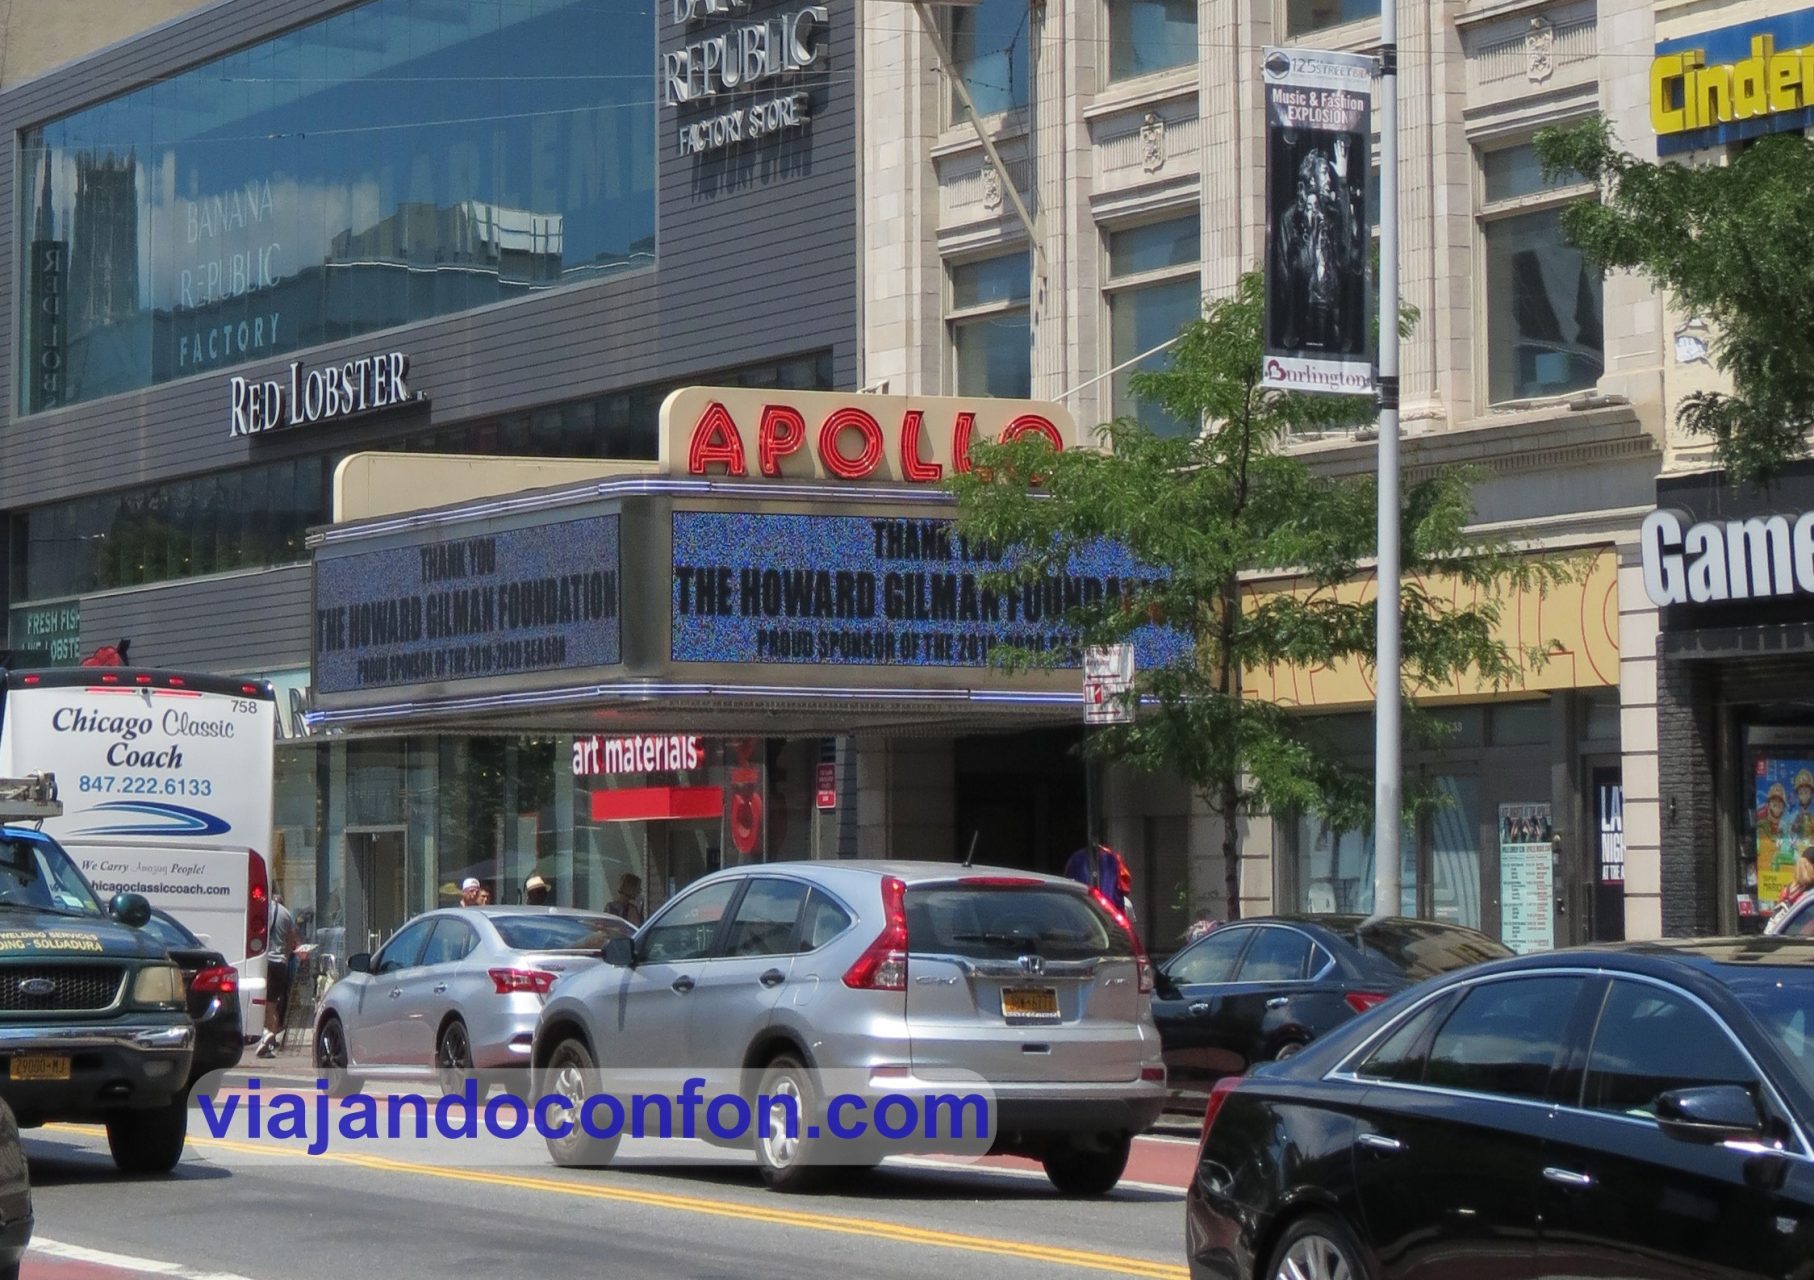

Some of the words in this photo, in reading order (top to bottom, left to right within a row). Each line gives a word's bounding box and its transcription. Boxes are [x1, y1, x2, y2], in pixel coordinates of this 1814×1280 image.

[663, 6, 828, 107] REPUBLIC
[1272, 88, 1306, 106] Music
[1309, 92, 1319, 107] &
[1321, 91, 1364, 112] Fashion
[1288, 105, 1349, 124] EXPLOSION
[679, 109, 744, 157] FACTORY
[749, 93, 809, 137] STORE
[187, 178, 273, 244] BANANA
[181, 242, 281, 311] REPUBLIC
[180, 313, 280, 367] FACTORY
[1266, 359, 1371, 390] Burlington
[229, 375, 281, 438] RED
[289, 352, 408, 425] LOBSTER
[420, 541, 467, 584] THANK
[468, 538, 496, 576] YOU
[318, 606, 345, 652] THE
[350, 596, 422, 647] HOWARD
[426, 586, 494, 638] GILMAN
[499, 570, 617, 631] FOUNDATION
[676, 568, 732, 616] THE
[740, 569, 875, 619] HOWARD
[884, 571, 999, 621] GILMAN
[27, 611, 58, 635] FRESH
[757, 629, 813, 658] PROUD
[819, 630, 895, 659] SPONSOR
[900, 631, 919, 660] OF
[923, 632, 952, 661] THE
[52, 707, 153, 740] Chicago
[162, 708, 235, 738] Classic
[231, 700, 258, 714] 758
[107, 742, 183, 769] Coach
[573, 736, 599, 775] art
[605, 735, 698, 773] materials
[79, 775, 212, 796] 847.222.6133
[1601, 785, 1623, 832] LA
[81, 860, 98, 870] We
[100, 861, 129, 873] Carry
[171, 862, 206, 875] People!
[91, 881, 230, 896] hicagoclassiccoach.com
[33, 939, 103, 952] SOLDADURA
